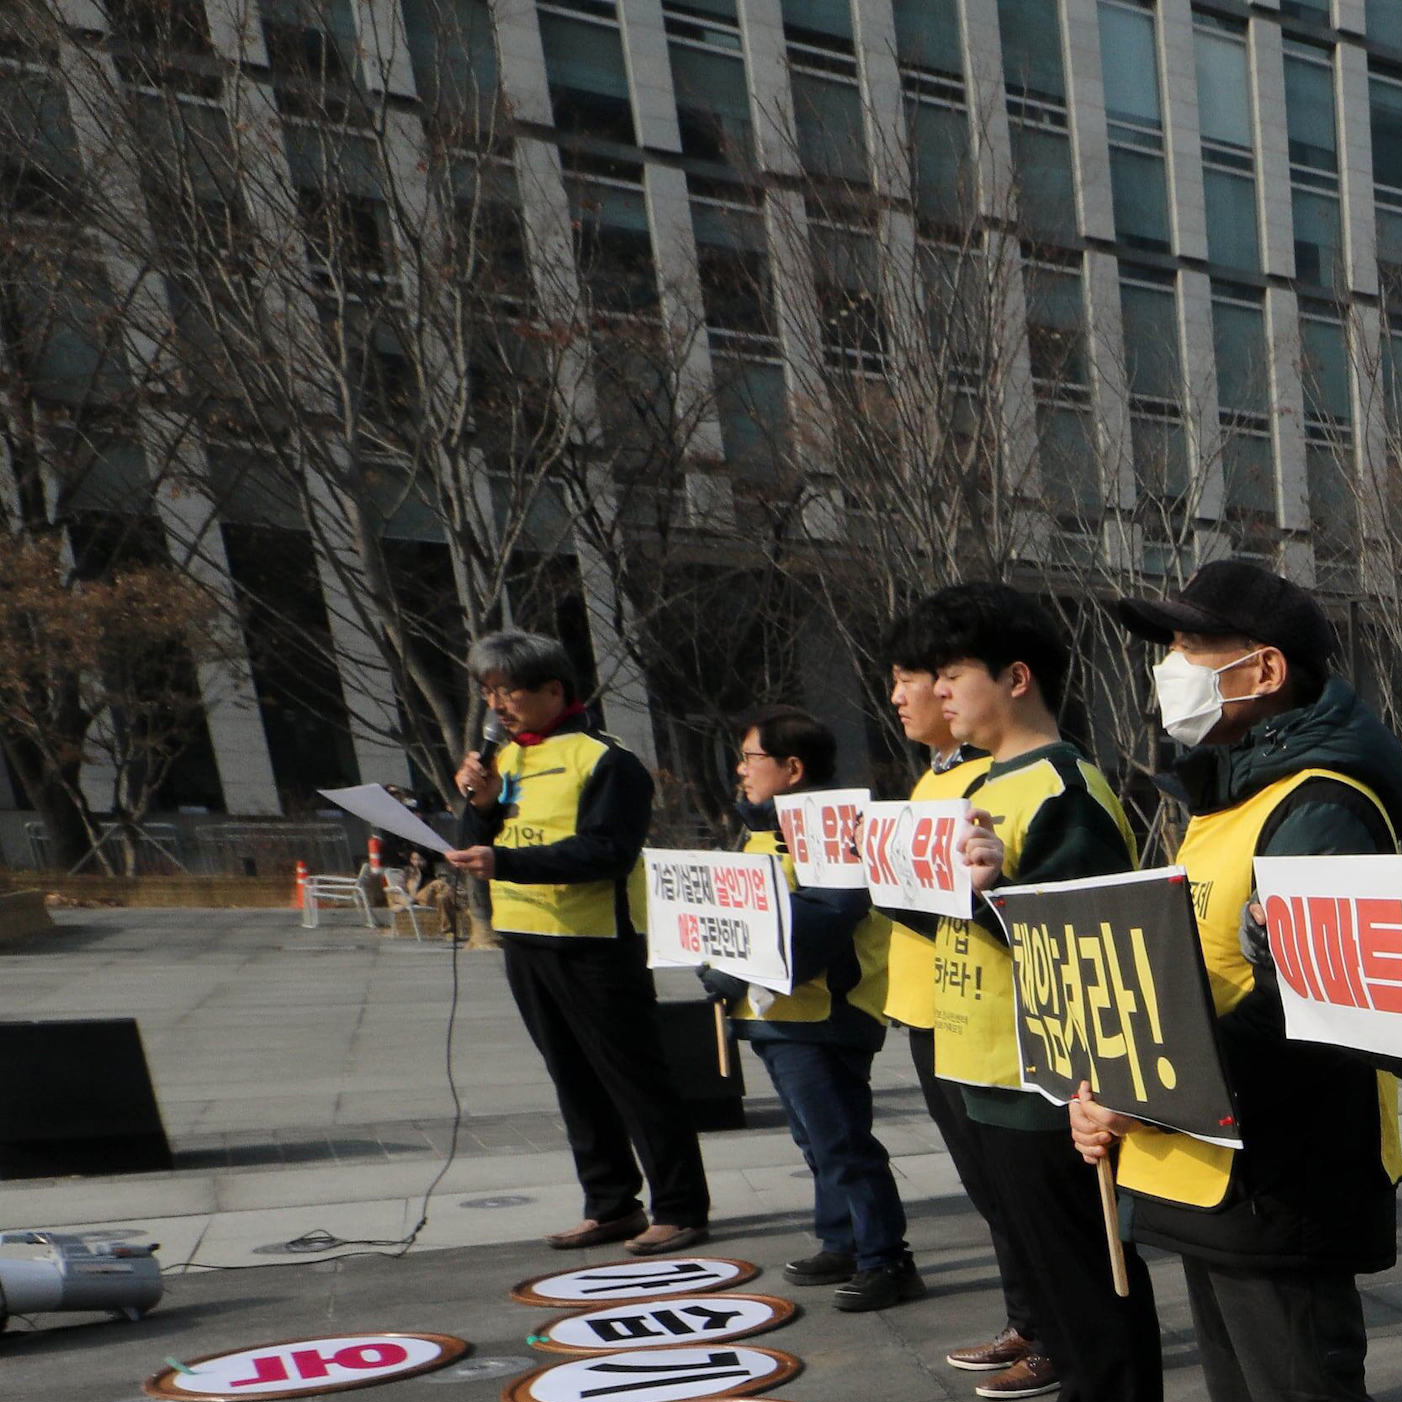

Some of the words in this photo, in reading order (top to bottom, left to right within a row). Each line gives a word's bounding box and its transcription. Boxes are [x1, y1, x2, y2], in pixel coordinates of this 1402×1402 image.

[780, 808, 809, 864] 애경
[822, 804, 863, 864] 유죄
[867, 817, 899, 886] SK
[911, 817, 956, 892] 유죄
[652, 863, 715, 906] 가습기살균제
[713, 866, 769, 912] 살인기업
[677, 913, 701, 953] 애경
[934, 957, 983, 1001] 하라!
[1011, 921, 1177, 1102] 책임져라!
[578, 1263, 721, 1294] 가
[586, 1305, 742, 1342] 습
[231, 1343, 407, 1387] 옥
[581, 1351, 751, 1398] 기
